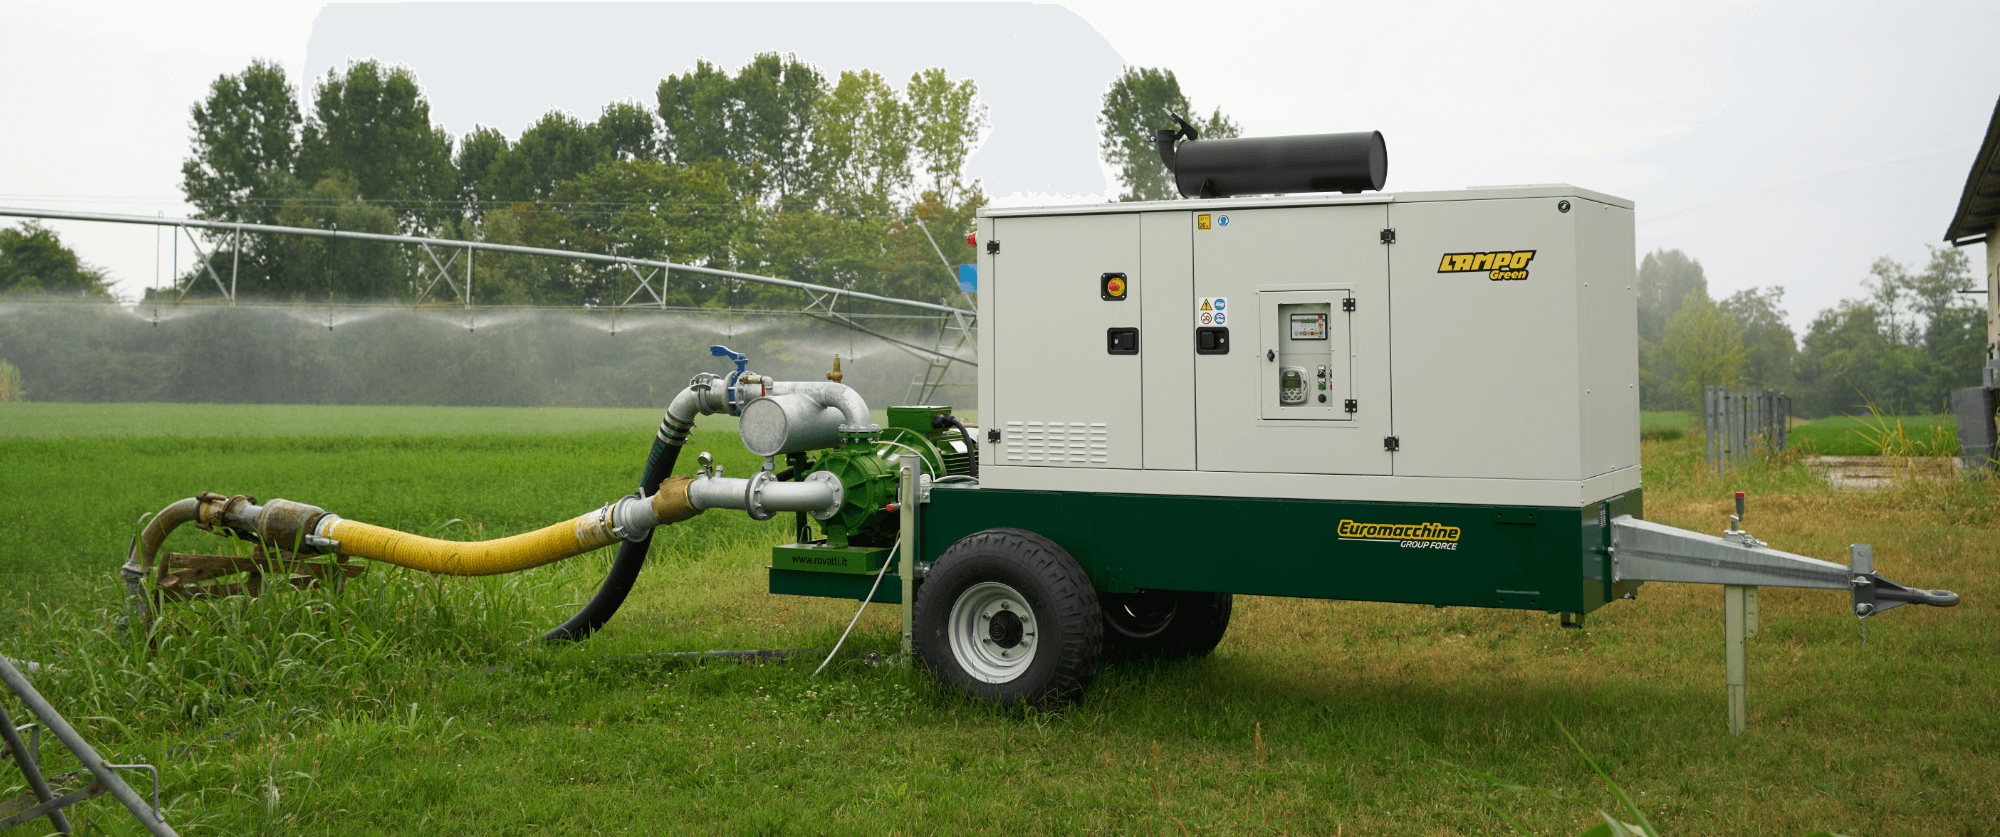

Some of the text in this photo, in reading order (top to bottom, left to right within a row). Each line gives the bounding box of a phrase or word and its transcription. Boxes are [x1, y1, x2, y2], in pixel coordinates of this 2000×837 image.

[1438, 251, 1535, 272] LAMPO
[1489, 269, 1528, 280] Green
[1338, 520, 1460, 540] Euromacchine
[1400, 540, 1458, 550] GROUP FORCE
[791, 556, 848, 567] www.rovatti.it
